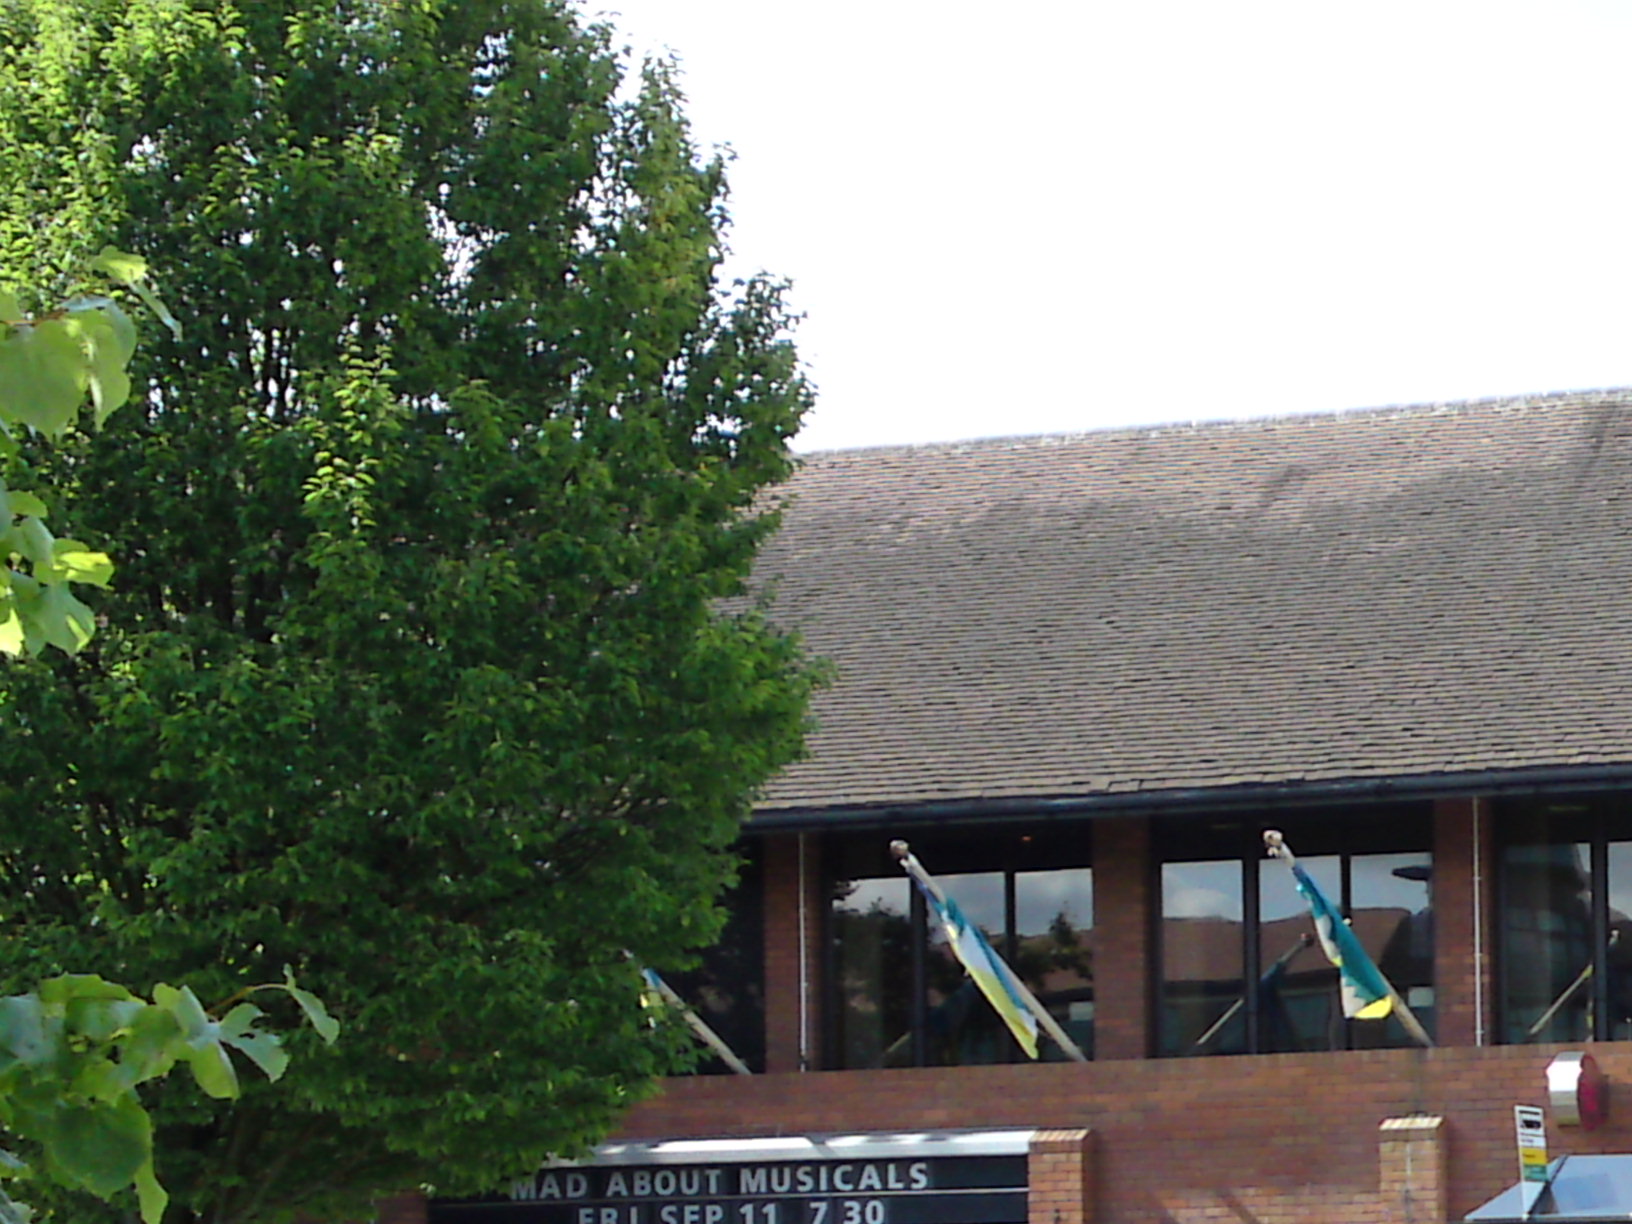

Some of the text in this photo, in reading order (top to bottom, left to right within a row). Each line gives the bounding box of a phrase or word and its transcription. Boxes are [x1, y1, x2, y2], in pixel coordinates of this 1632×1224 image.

[511, 1162, 929, 1200] MAD ABOUT MUSICALS
